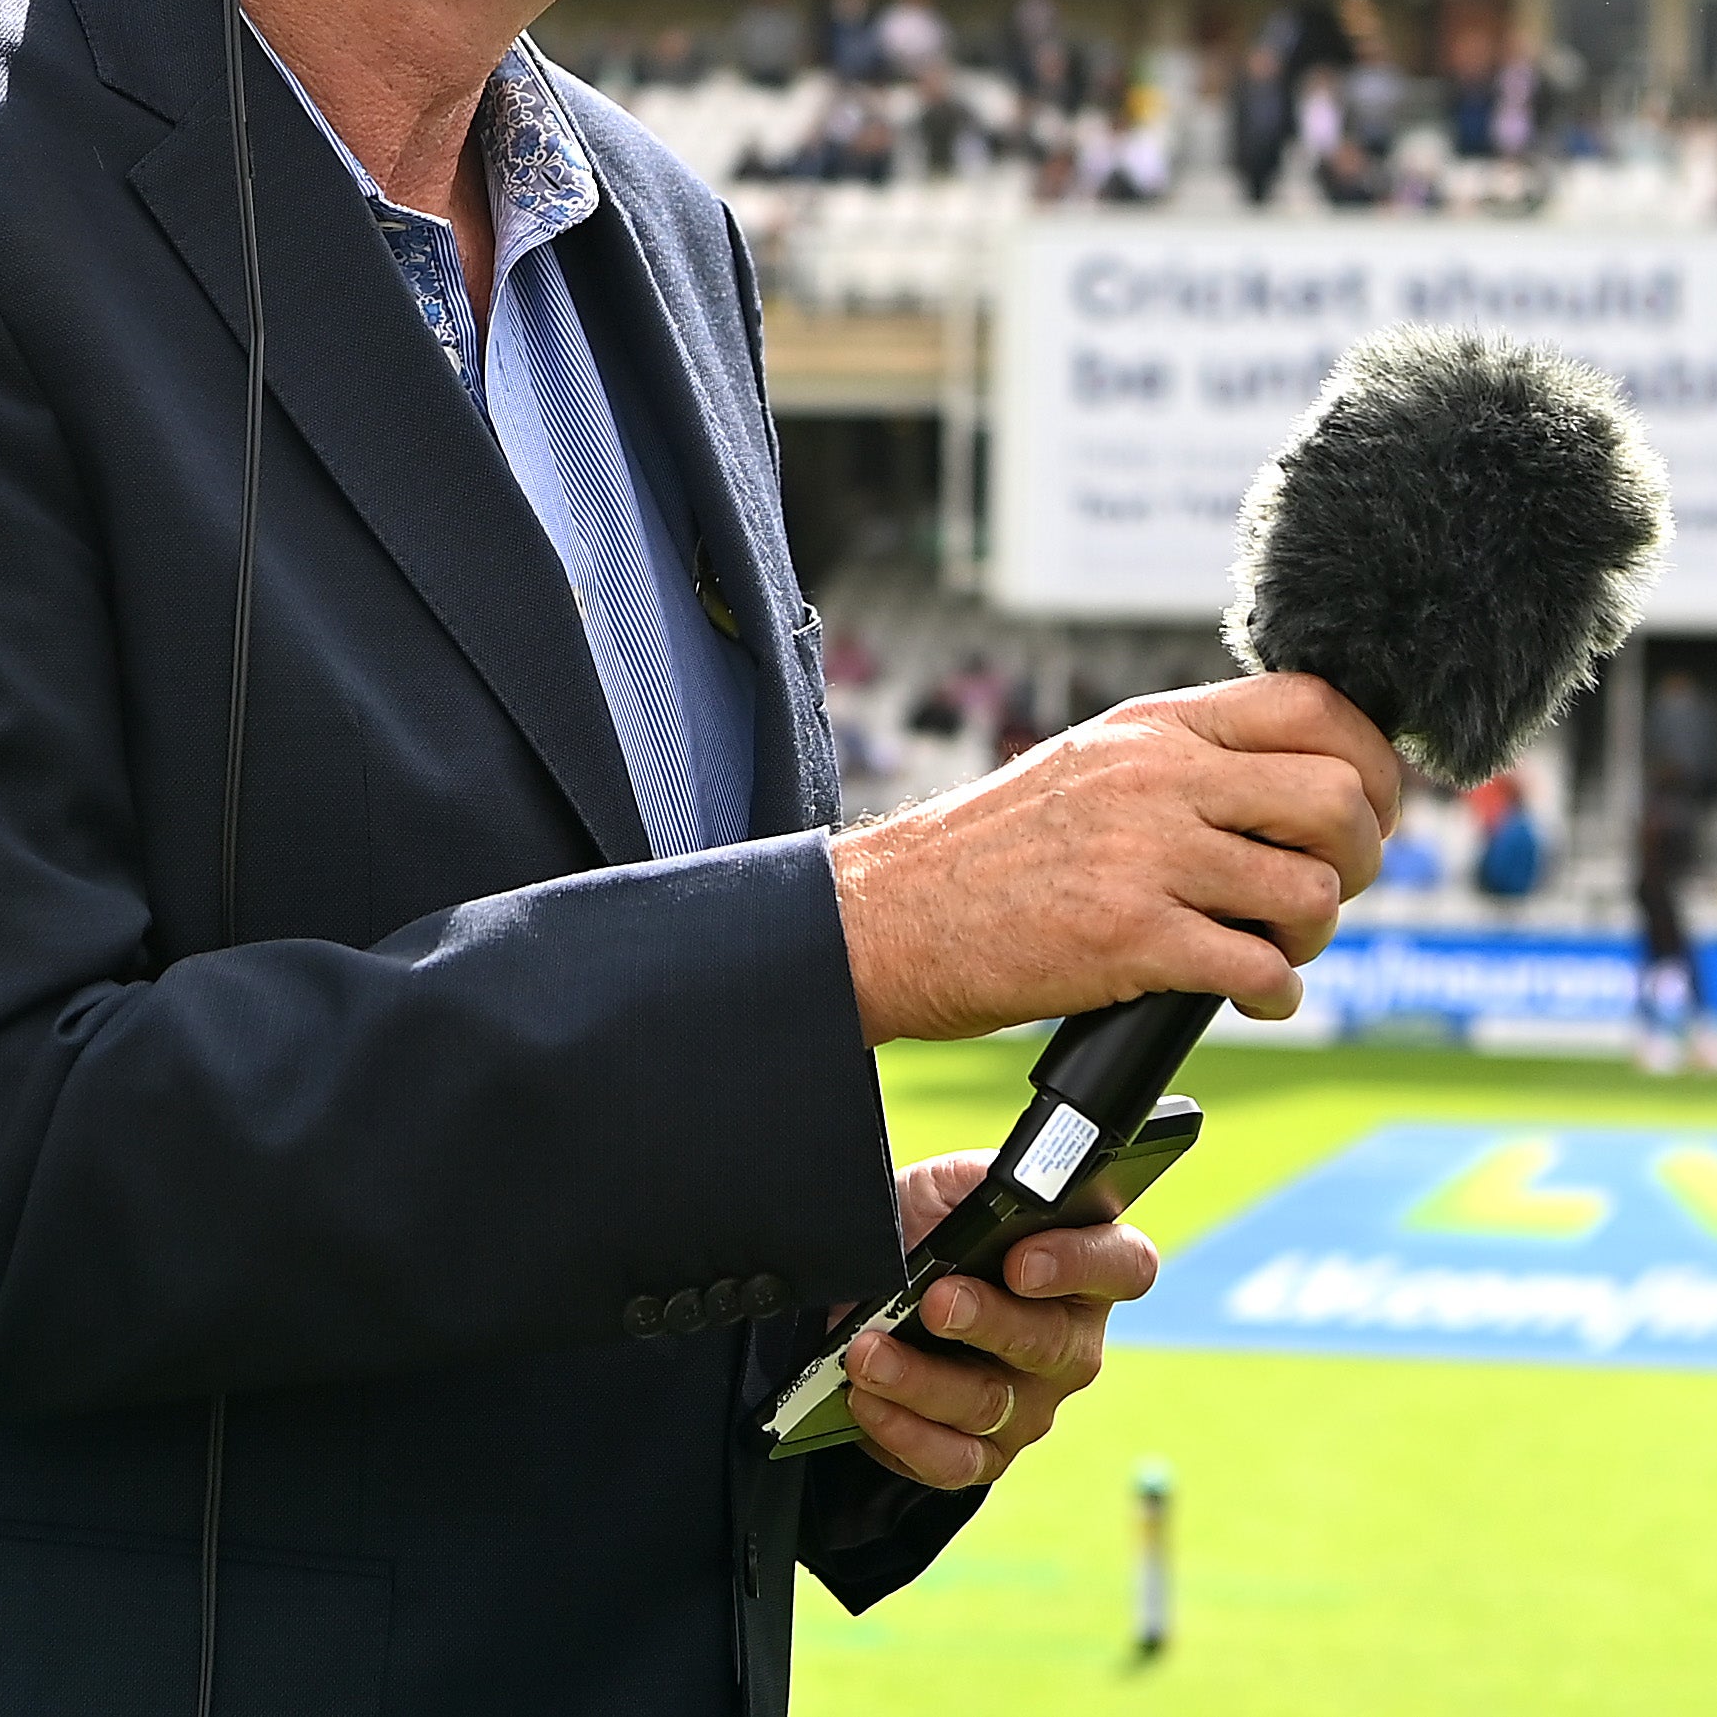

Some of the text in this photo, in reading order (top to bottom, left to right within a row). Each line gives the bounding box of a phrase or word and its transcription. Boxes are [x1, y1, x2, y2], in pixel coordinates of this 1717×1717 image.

[1069, 256, 1684, 322] Cricket should
[1069, 348, 1176, 408] be
